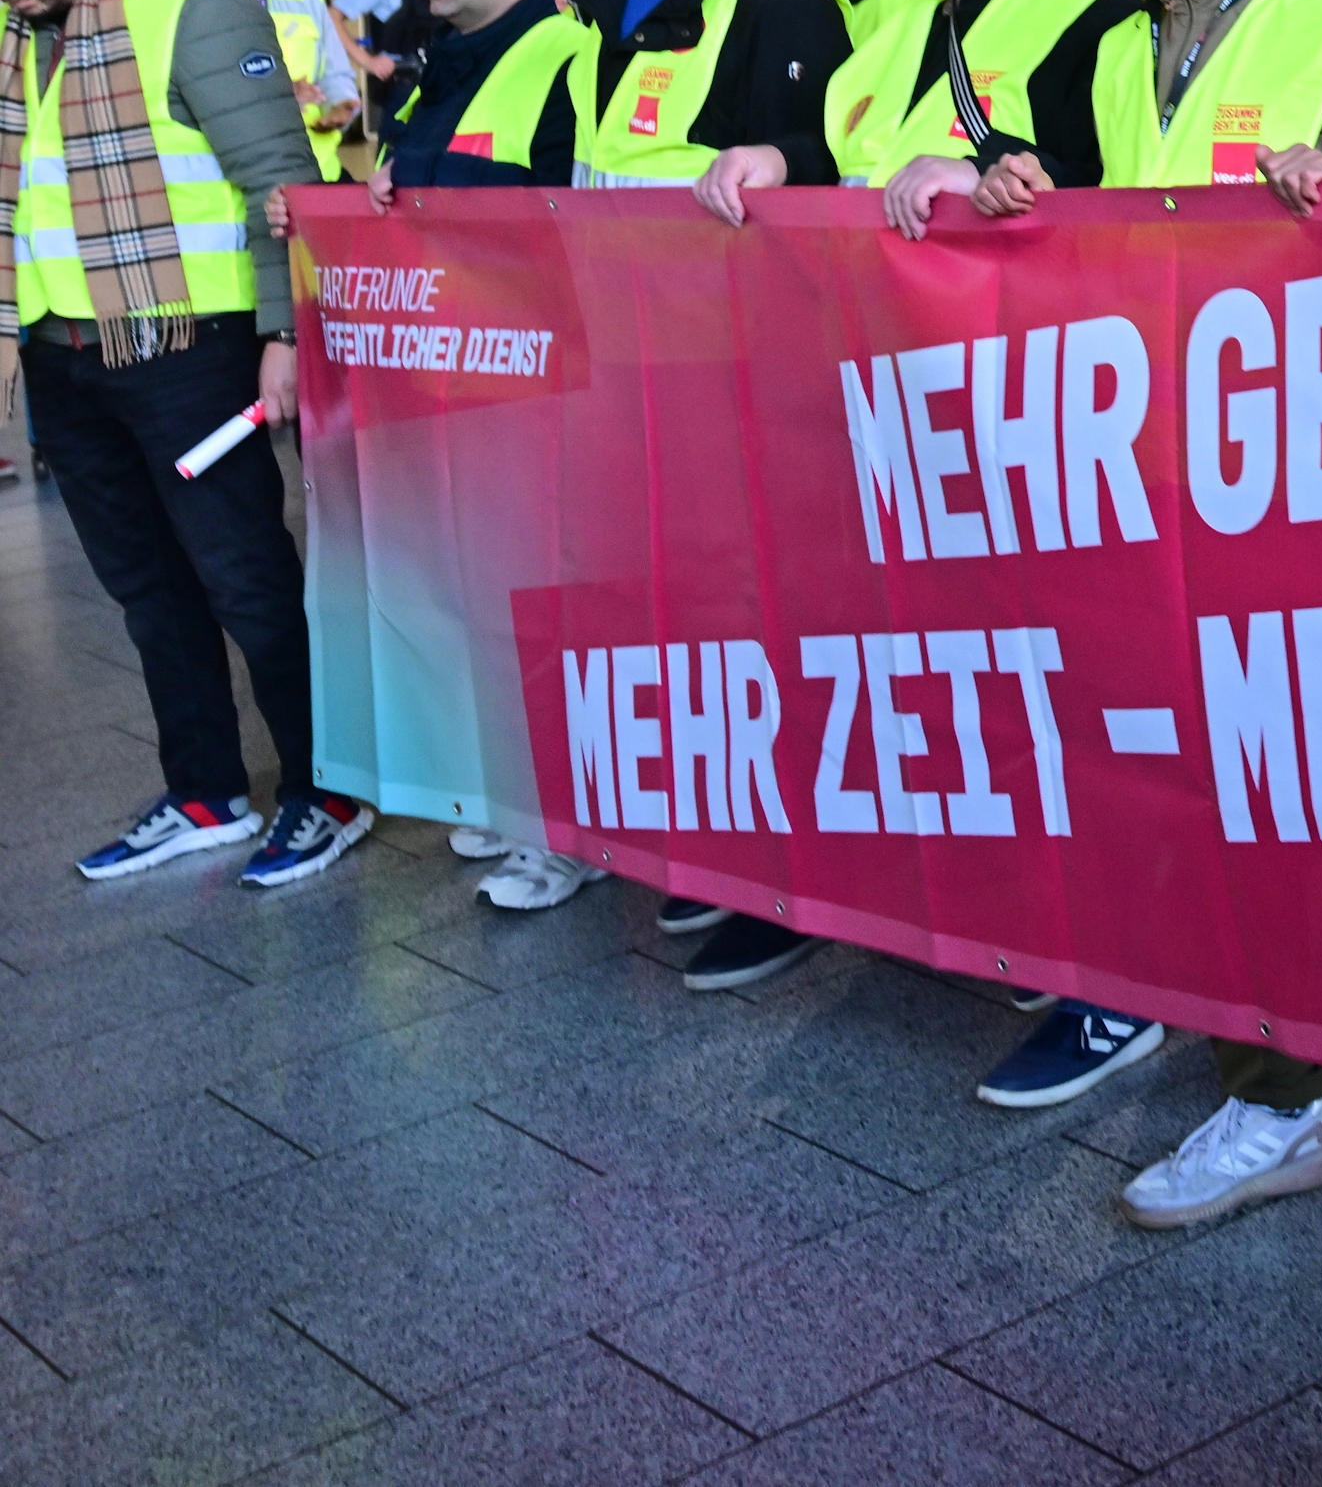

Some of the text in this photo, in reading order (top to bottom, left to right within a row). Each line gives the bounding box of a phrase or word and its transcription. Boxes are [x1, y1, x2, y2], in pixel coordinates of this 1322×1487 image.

[313, 266, 445, 312] TARIFRUNDE
[463, 327, 553, 377] DIENST
[839, 315, 1159, 564] MEHR
[562, 640, 793, 835] MEHR
[800, 627, 1072, 837] ZEIT
